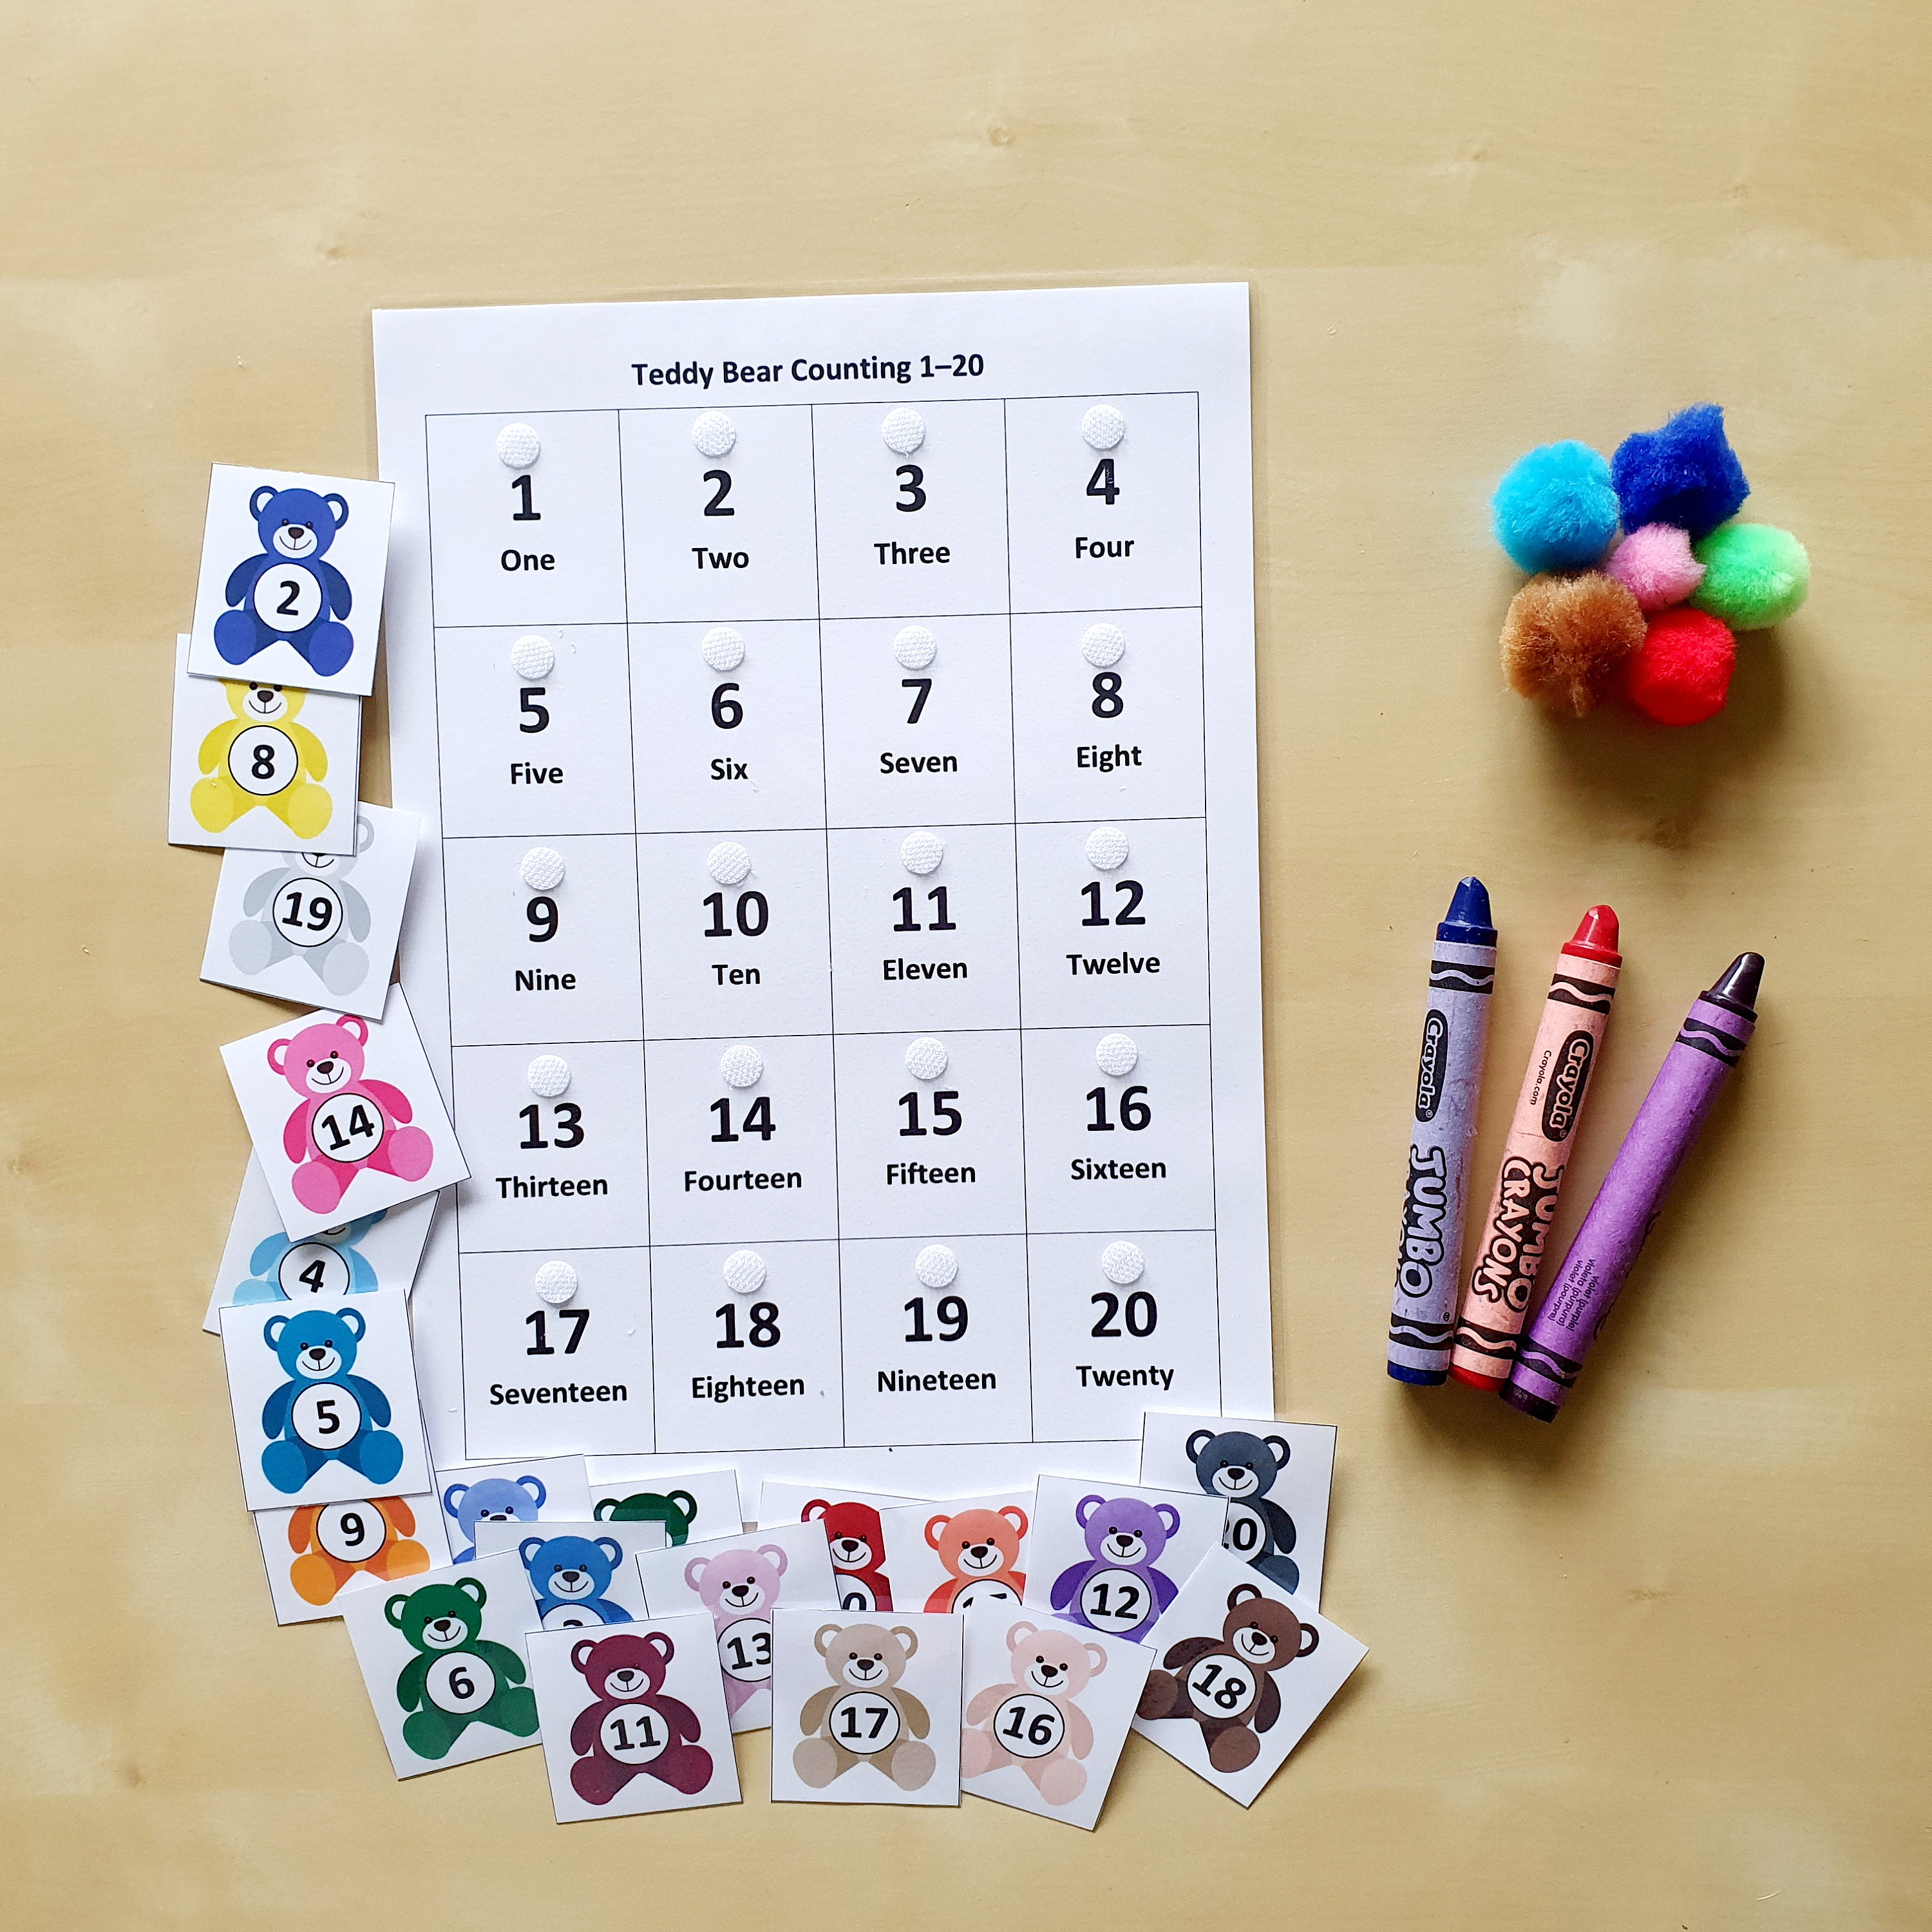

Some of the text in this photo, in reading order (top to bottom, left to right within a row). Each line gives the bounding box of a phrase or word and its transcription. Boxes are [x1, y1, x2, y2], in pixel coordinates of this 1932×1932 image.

[631, 354, 984, 390] Teddy Bear Counting 1–20
[511, 475, 542, 521] 1
[703, 469, 735, 516] 2
[896, 464, 927, 513] 3
[1086, 458, 1120, 506] 4
[501, 549, 555, 571] One
[691, 547, 749, 569] Two
[873, 541, 951, 565] Three
[1075, 536, 1135, 559] Four
[276, 580, 300, 616] 2
[519, 687, 549, 734] 5
[711, 682, 743, 730] 6
[902, 678, 933, 724] 7
[1092, 672, 1124, 719] 8
[251, 744, 275, 780] 8
[511, 762, 564, 784] Five
[711, 757, 748, 781] Six
[880, 752, 958, 774] Seven
[1077, 744, 1142, 773] Eight
[281, 891, 332, 931] 19
[526, 896, 558, 943] 9
[703, 891, 769, 937] 10
[893, 886, 956, 932] 11
[1081, 880, 1146, 927] 12
[515, 968, 576, 992] Nine
[711, 964, 761, 985] Ten
[883, 958, 967, 981] Eleven
[1066, 951, 1160, 976] Twelve
[1530, 1049, 1552, 1106] Crayola.com
[519, 1103, 585, 1150] 13
[710, 1096, 776, 1142] 14
[898, 1090, 962, 1137] 15
[1086, 1085, 1151, 1132] 16
[321, 1104, 375, 1151] 14
[495, 1175, 608, 1198] Thirteen
[685, 1170, 802, 1192] Fourteen
[887, 1162, 976, 1185] Fifteen
[1071, 1158, 1166, 1180] Sixteen
[1399, 1145, 1447, 1297] JUMBO
[1473, 1157, 1532, 1302] CRAYONS
[299, 1259, 326, 1293] 4
[1567, 1260, 1583, 1283] violet
[1577, 1258, 1595, 1287] violeta
[1583, 1275, 1600, 1299] violet
[526, 1309, 590, 1356] 17
[715, 1302, 781, 1349] 18
[904, 1295, 969, 1342] 19
[1091, 1291, 1157, 1338] 20
[490, 1383, 627, 1405] Seventeen
[692, 1374, 804, 1403] Eighteen
[878, 1369, 996, 1392] Nineteen
[1075, 1365, 1175, 1391] Twenty
[316, 1399, 340, 1434] 5
[340, 1512, 365, 1547] 9
[1224, 1517, 1258, 1551] 0
[1090, 1583, 1140, 1620] 12
[726, 1631, 772, 1671] 13
[449, 1666, 475, 1700] 6
[1191, 1664, 1247, 1710] 18
[610, 1716, 661, 1751] 11
[840, 1707, 889, 1739] 17
[1002, 1706, 1056, 1745] 16
